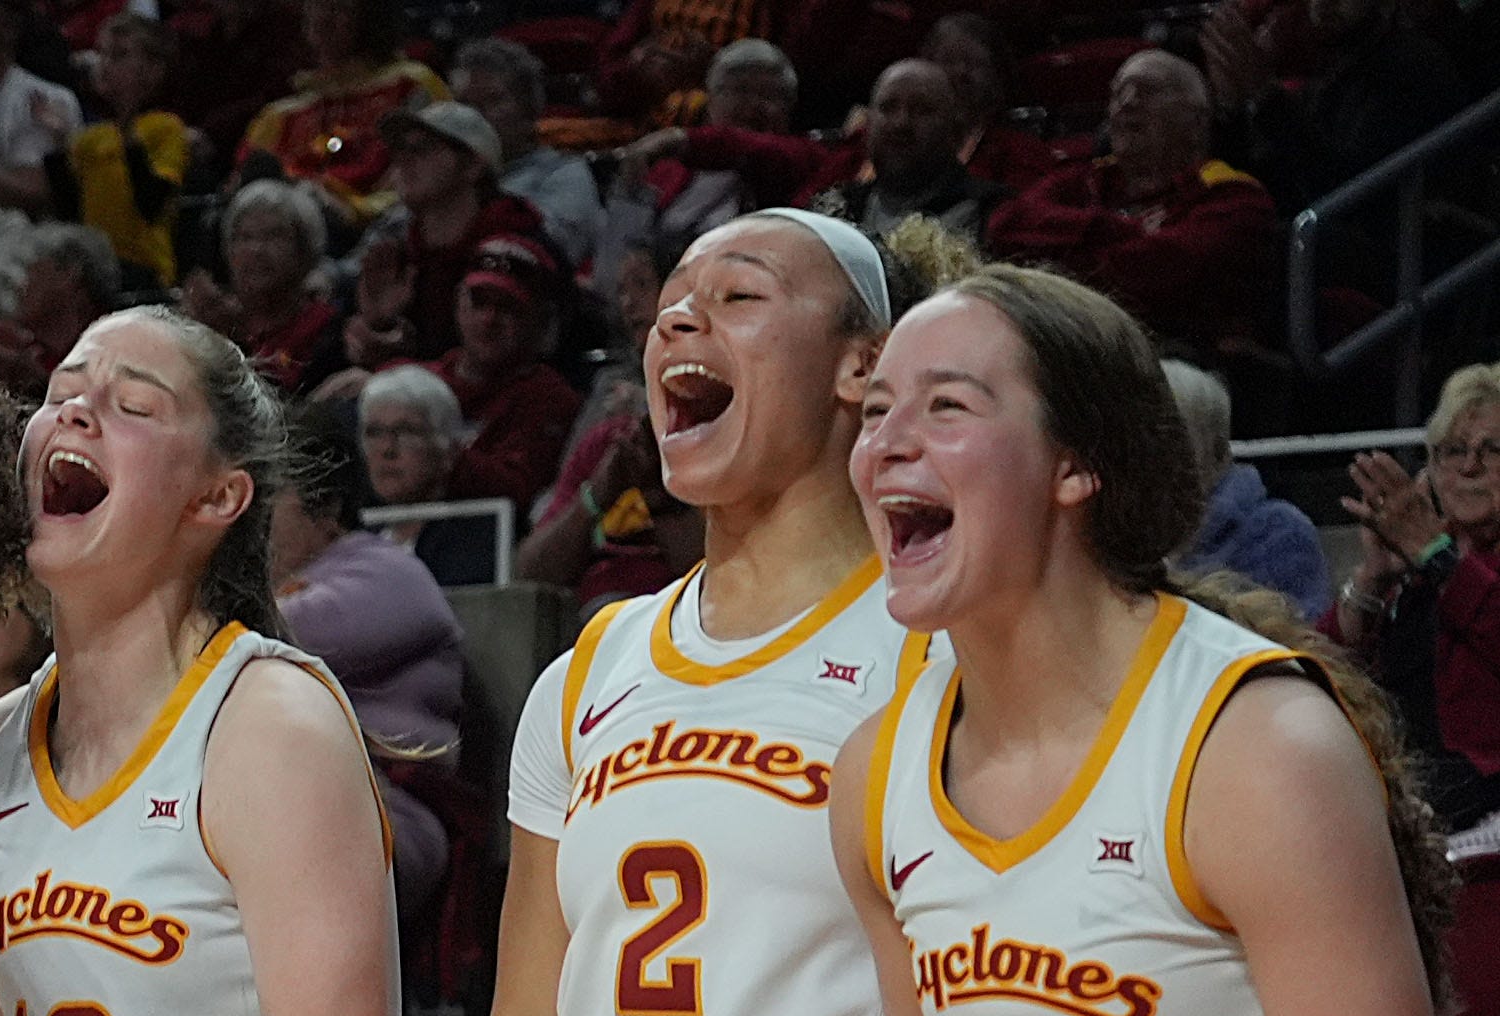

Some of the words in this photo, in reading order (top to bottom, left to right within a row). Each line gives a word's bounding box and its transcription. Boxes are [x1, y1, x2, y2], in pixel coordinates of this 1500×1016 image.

[818, 658, 862, 685] XII
[147, 797, 181, 820] XII
[1097, 838, 1135, 863] XII
